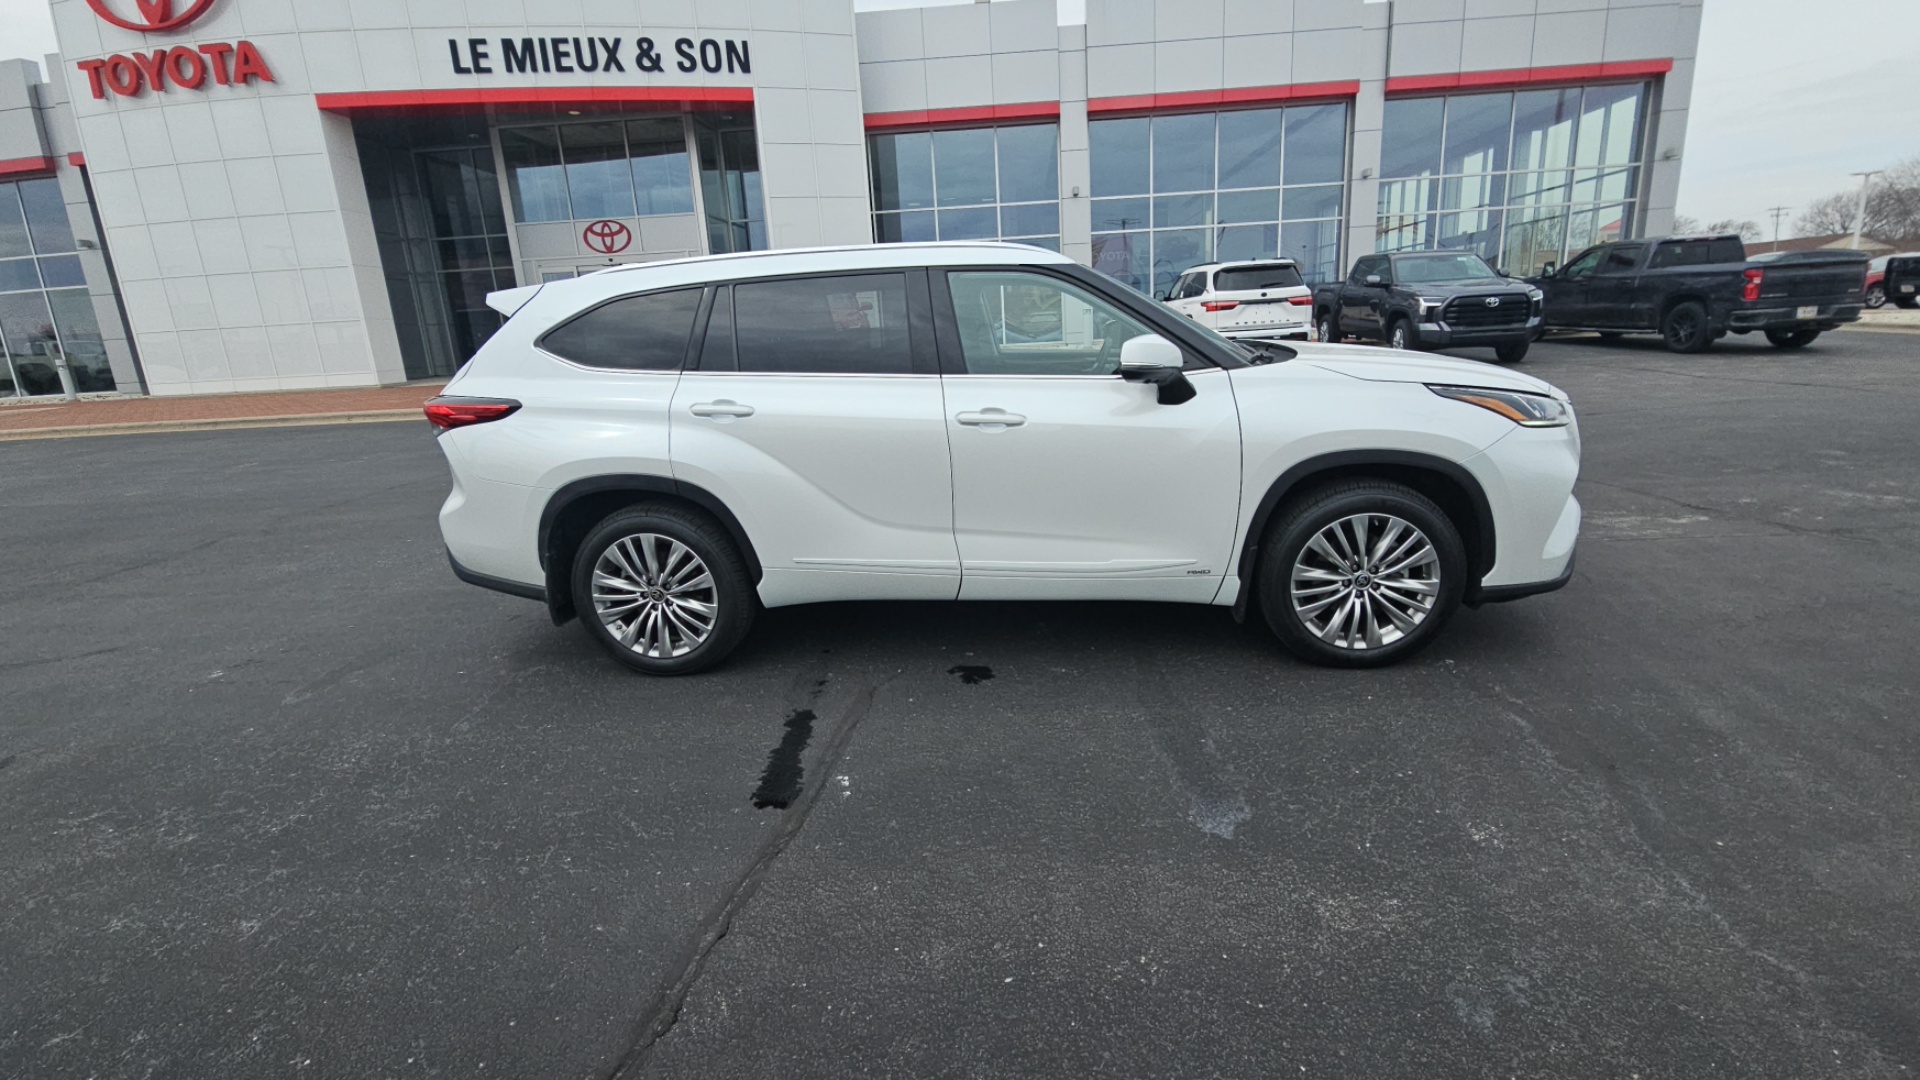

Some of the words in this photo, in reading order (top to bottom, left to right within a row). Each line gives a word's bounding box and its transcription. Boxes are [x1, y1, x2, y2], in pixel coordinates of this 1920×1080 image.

[77, 40, 276, 101] TOYOTA
[448, 38, 493, 75] LE
[500, 36, 626, 74] MIEUX
[635, 36, 665, 73] &
[674, 37, 752, 75] SON
